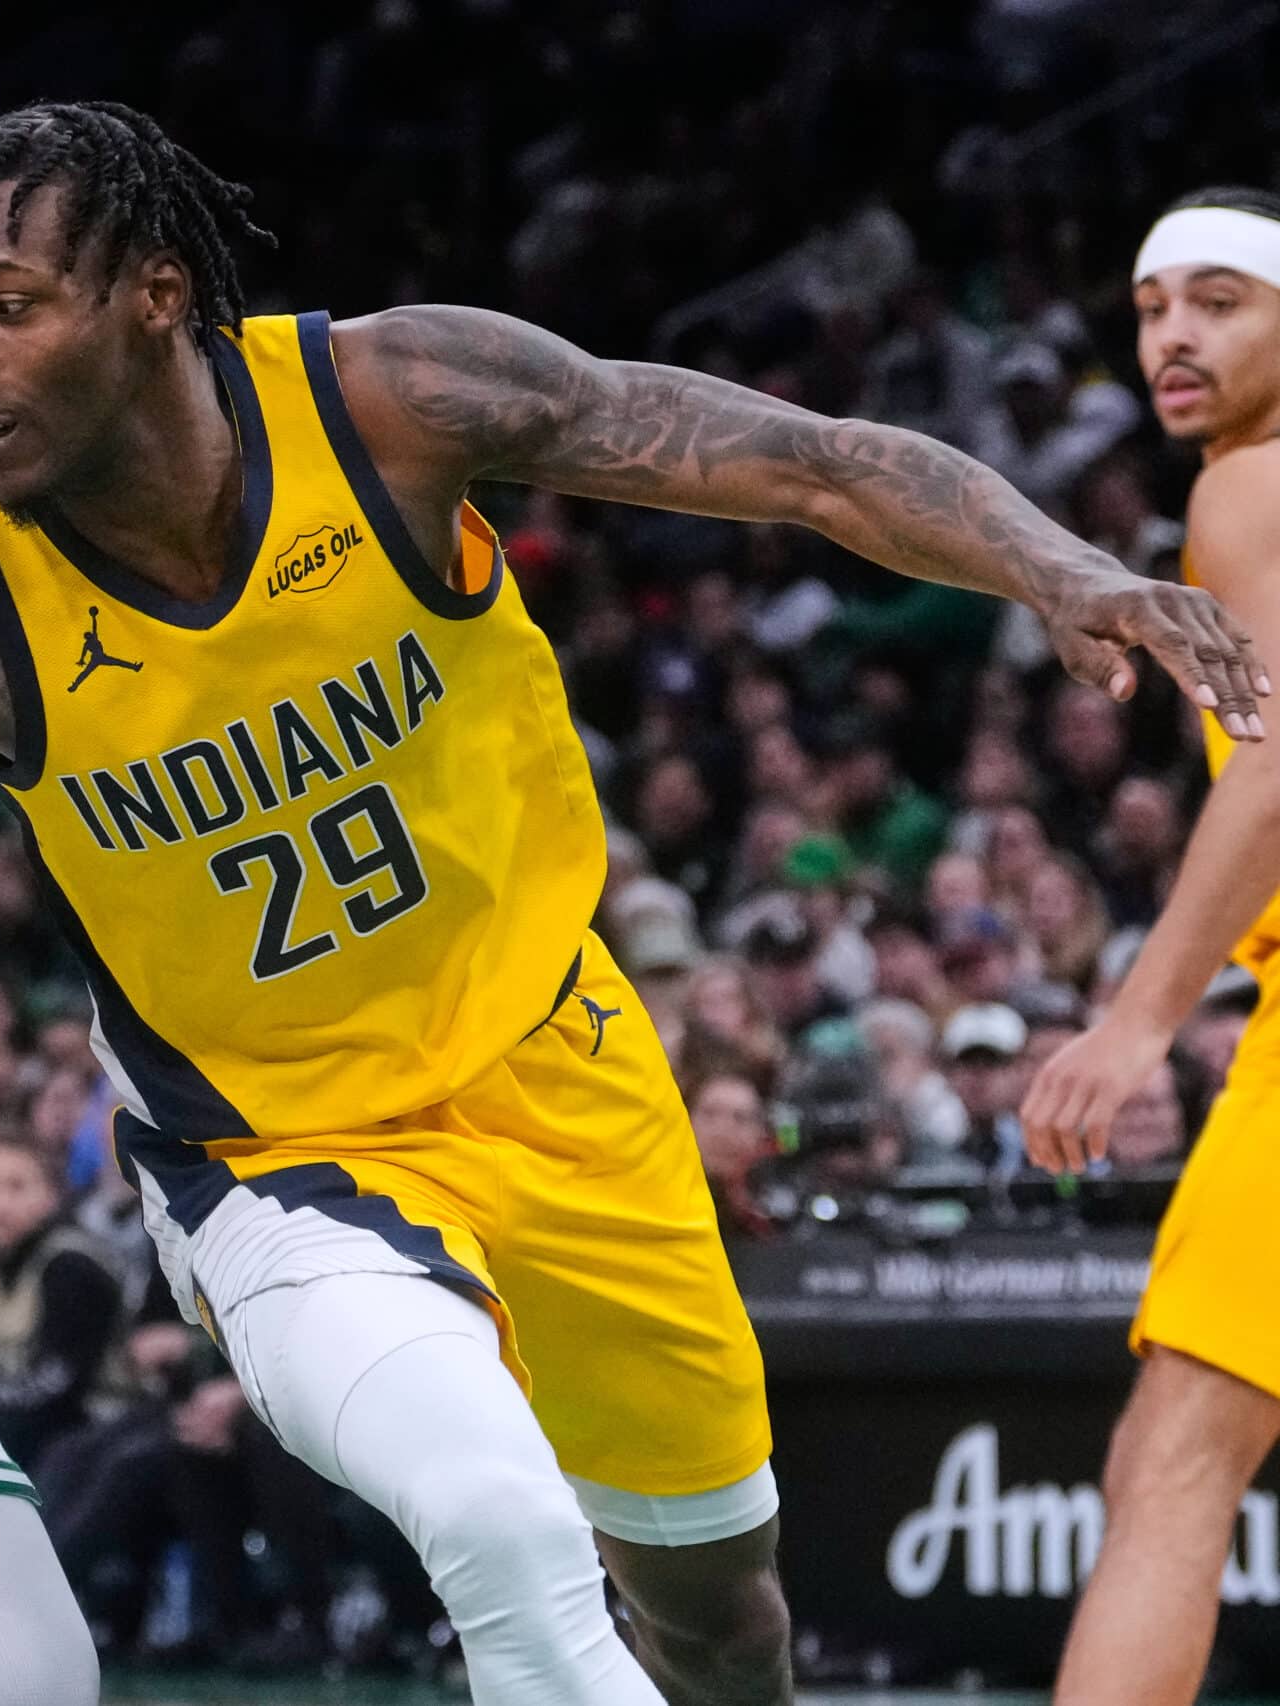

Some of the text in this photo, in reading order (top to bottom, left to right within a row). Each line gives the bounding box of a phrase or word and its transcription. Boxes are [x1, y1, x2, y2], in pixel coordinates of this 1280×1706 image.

[267, 524, 363, 599] LUCAS OIL
[58, 629, 446, 851] INDIANA
[207, 781, 429, 983] 29
[885, 1421, 1280, 1605] Ama
